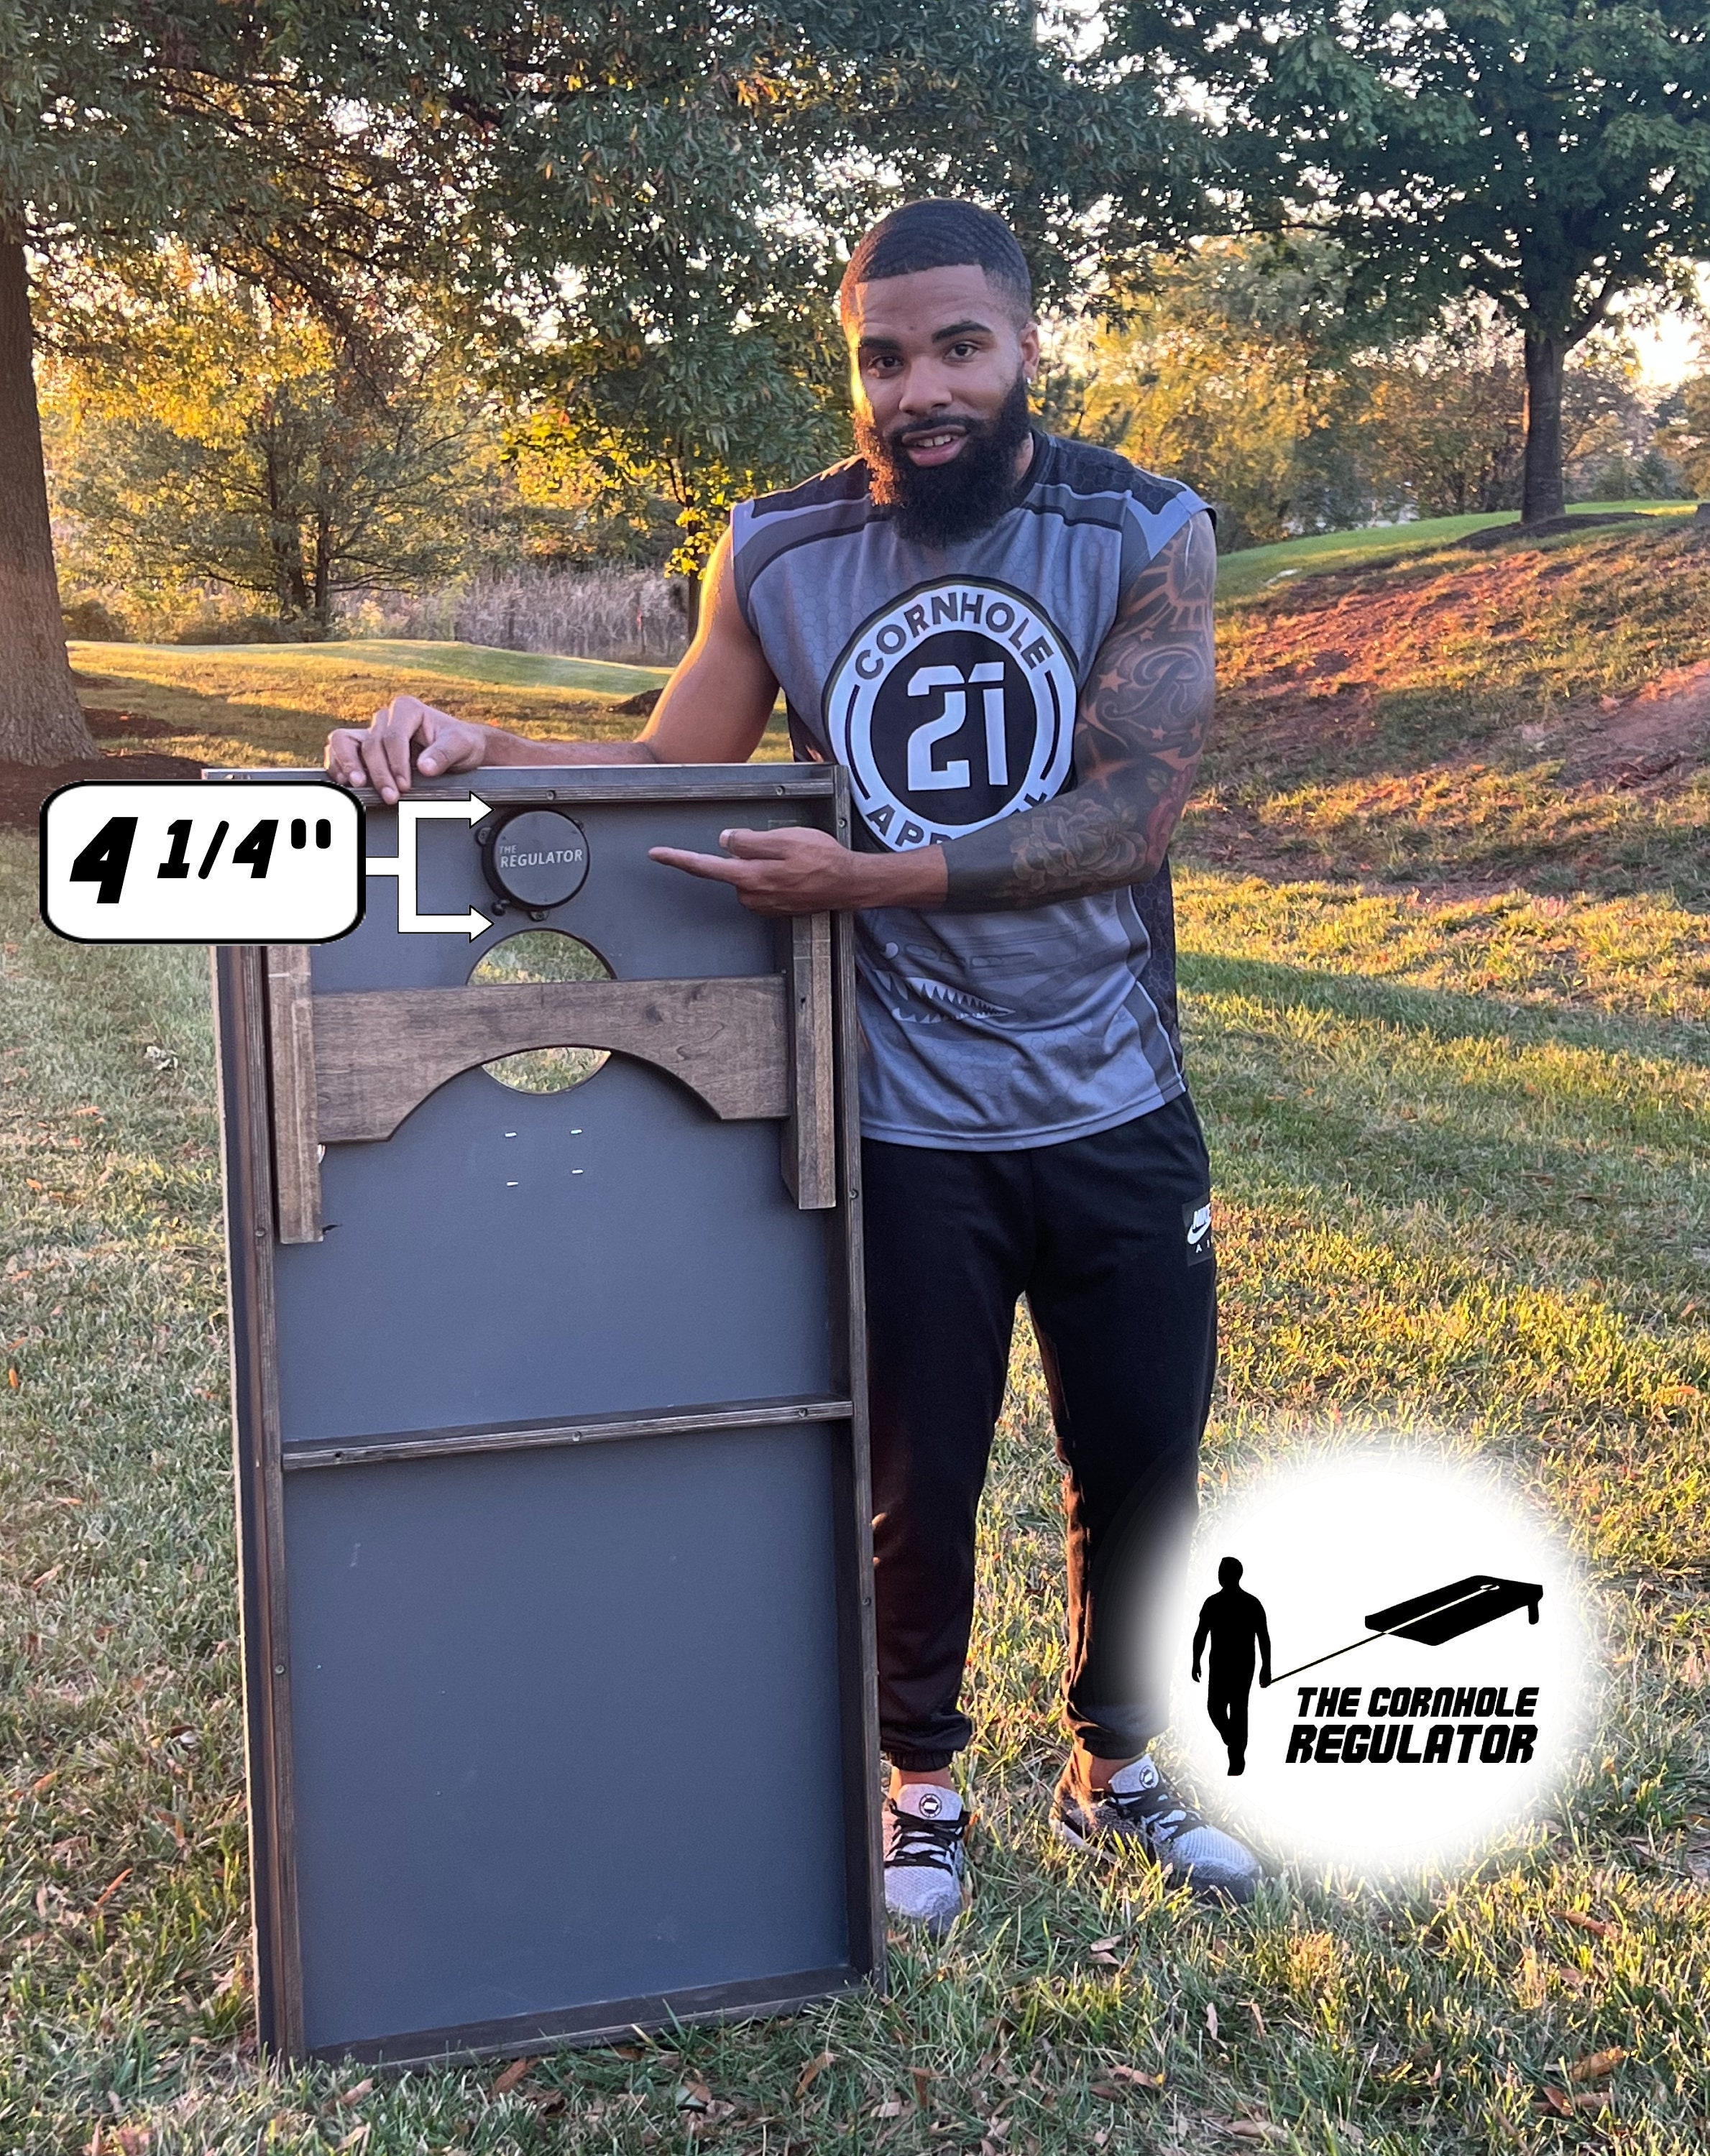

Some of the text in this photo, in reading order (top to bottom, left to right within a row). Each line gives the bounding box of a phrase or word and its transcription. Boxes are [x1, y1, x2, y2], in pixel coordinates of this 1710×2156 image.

[855, 592, 1054, 680] CORNHOLE
[907, 661, 1008, 791] 21
[499, 844, 518, 854] THE
[500, 849, 583, 868] REGULATOR
